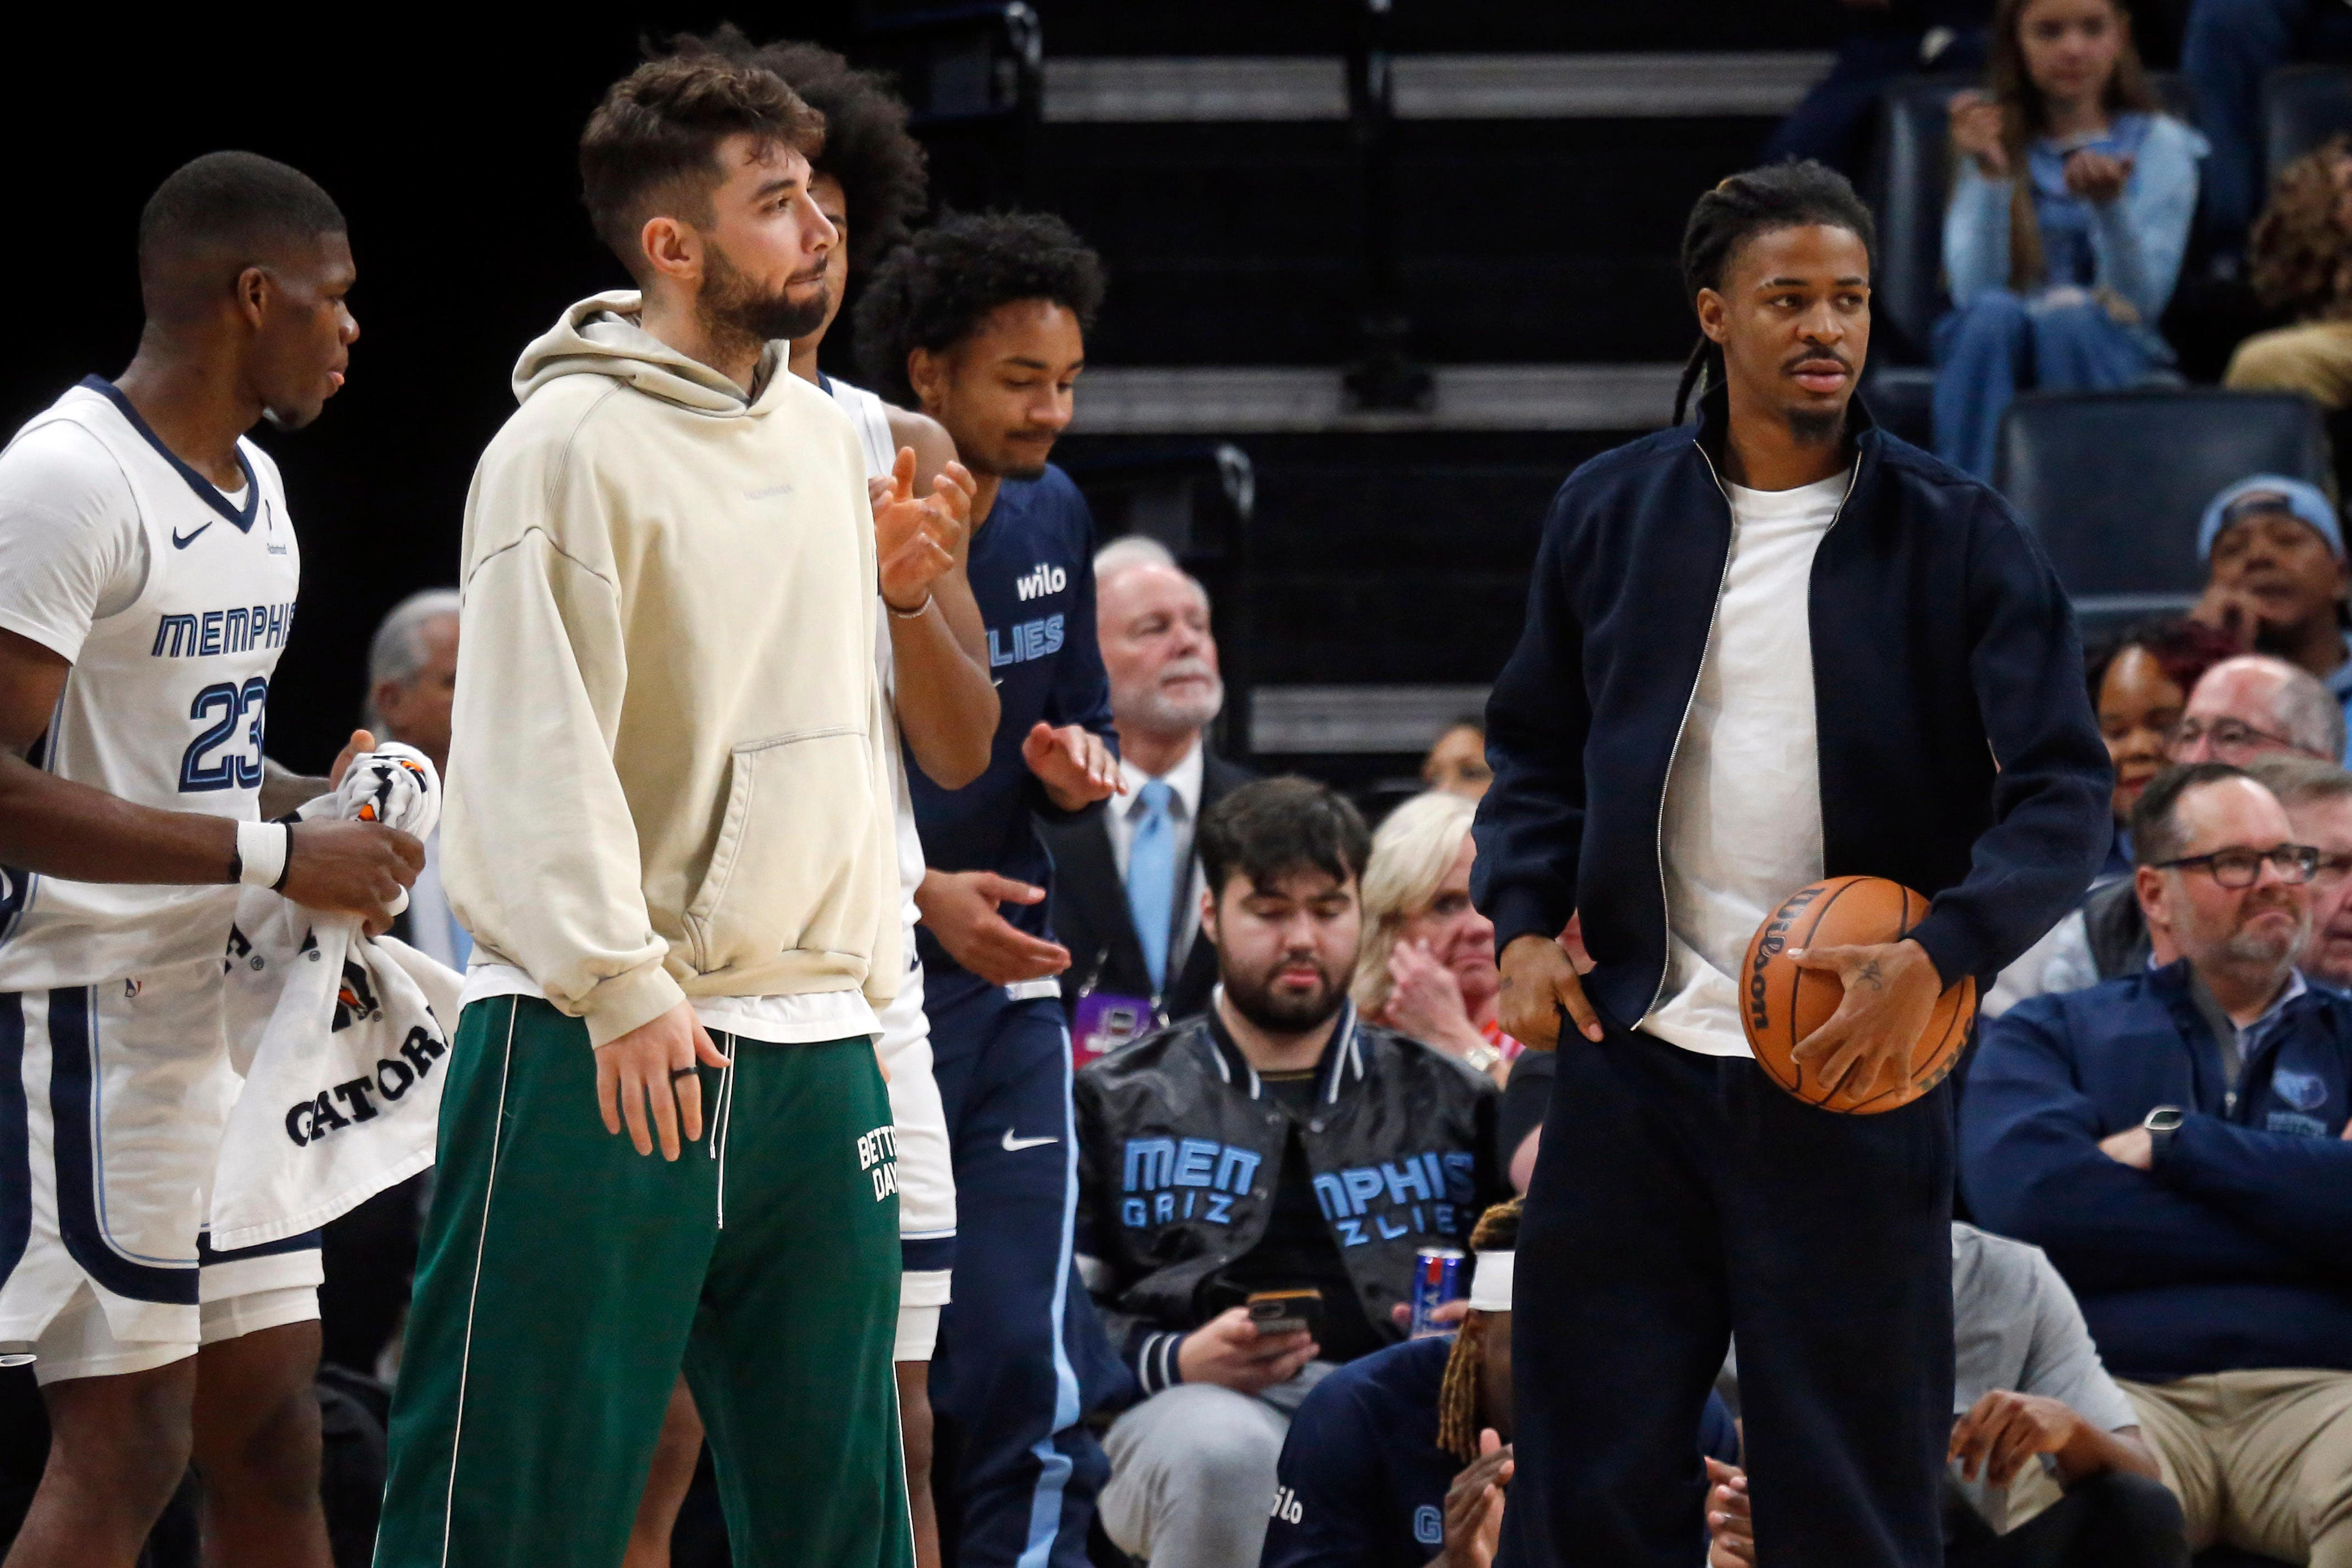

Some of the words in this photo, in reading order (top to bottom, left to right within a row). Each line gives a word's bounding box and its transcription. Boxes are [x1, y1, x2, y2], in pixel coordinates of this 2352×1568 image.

[1017, 562, 1067, 602] wilo
[985, 614, 1064, 667] LIES
[178, 676, 267, 793] 23
[1751, 887, 1825, 1030] Wilson
[285, 1004, 449, 1147] GATOR
[1122, 1191, 1234, 1228] GRIZ
[1336, 1203, 1475, 1246] ZLIE
[1270, 1485, 1303, 1524] ilo
